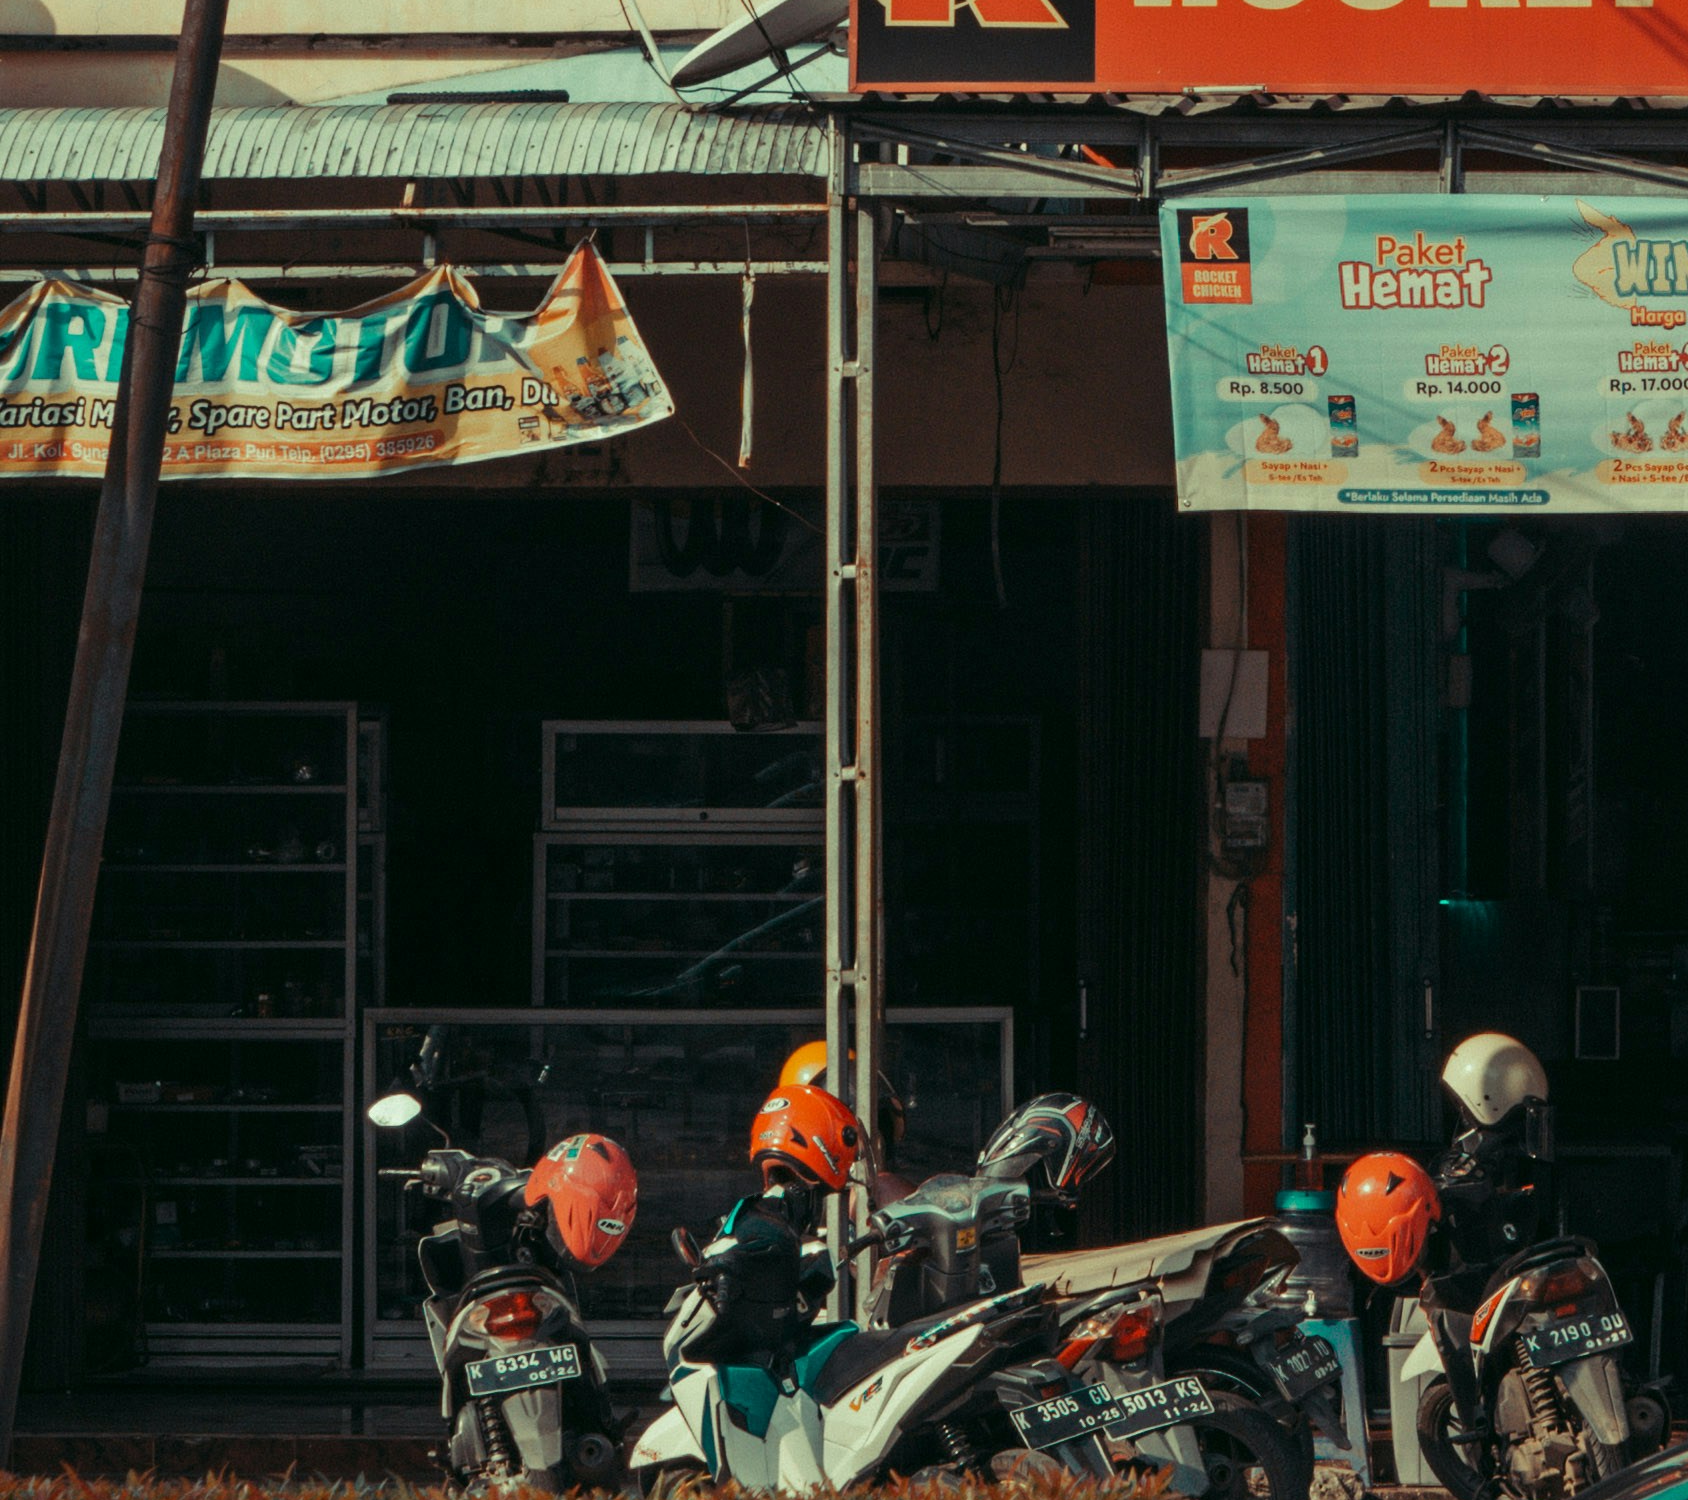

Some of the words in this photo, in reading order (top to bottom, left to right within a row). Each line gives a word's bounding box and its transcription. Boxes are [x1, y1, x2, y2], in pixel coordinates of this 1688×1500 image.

[1376, 232, 1465, 265] Paket
[1193, 270, 1237, 284] ROCKET
[1339, 260, 1492, 309] Hemat
[1192, 284, 1242, 298] CHICKEN
[1631, 306, 1686, 328] Harga
[1261, 345, 1295, 358] Paket
[1440, 345, 1477, 358] Paket
[1634, 342, 1672, 356] Paket
[1247, 353, 1307, 375] Hemat
[1311, 347, 1326, 373] 1
[1425, 353, 1487, 375] Hemat
[1490, 346, 1507, 373] 2
[1619, 351, 1680, 373] Hemat
[1230, 383, 1255, 396] Rp.
[1260, 383, 1304, 395] 8.500
[1416, 382, 1442, 397] Rp.
[1447, 381, 1501, 394] 14.000
[1610, 379, 1636, 394] Rp.
[192, 402, 268, 434] Spare
[276, 402, 337, 430] Part
[342, 396, 437, 429] Motor,
[445, 385, 515, 415] Ban,
[8, 444, 29, 459] Jl.
[34, 443, 67, 458] Kol.
[176, 446, 190, 460] A
[195, 445, 240, 460] Plaza
[245, 444, 276, 460] Puri
[279, 445, 316, 461] Telp.
[319, 443, 371, 463] (0295)
[376, 434, 435, 456] 385926
[1261, 462, 1291, 472] Sayap
[1300, 462, 1321, 471] Nasi
[1429, 461, 1438, 473] 2
[1440, 465, 1455, 474] Pcs
[1457, 465, 1484, 475] Sayap
[1494, 465, 1514, 473] Nasi
[1613, 460, 1623, 472] 2
[1625, 464, 1643, 472] Pcs
[1645, 463, 1675, 474] Sayap
[1619, 474, 1640, 483] Nasi
[1392, 491, 1428, 503] Selama
[1430, 492, 1486, 504] Persediaan
[1488, 493, 1518, 504] Masih
[1521, 493, 1542, 504] Ada
[1526, 1335, 1541, 1352] K
[1550, 1321, 1591, 1347] 2190
[470, 1364, 483, 1380] K
[495, 1351, 540, 1375] 6334
[1275, 1364, 1289, 1383] K
[1123, 1389, 1167, 1415] 5013
[1177, 1379, 1202, 1400] KS
[1015, 1411, 1031, 1431] K
[1037, 1396, 1080, 1423] 3505
